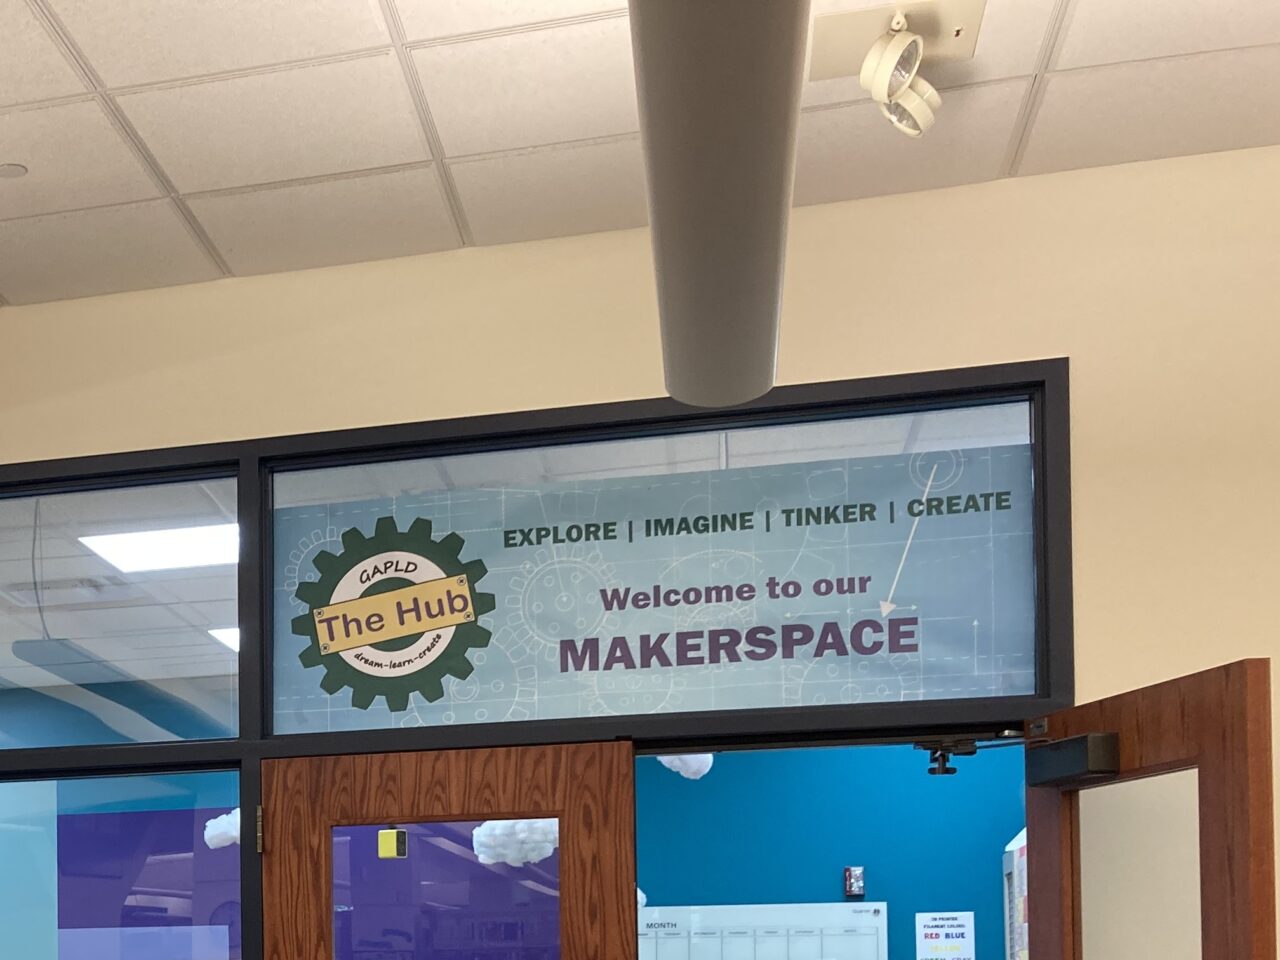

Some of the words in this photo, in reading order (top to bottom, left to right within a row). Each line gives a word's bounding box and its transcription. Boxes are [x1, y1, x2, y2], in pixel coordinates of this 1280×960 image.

[503, 521, 617, 548] EXPLORE
[644, 511, 754, 538] IMAGINE
[781, 502, 877, 528] TINKER
[907, 491, 1012, 518] CREATE
[359, 560, 418, 584] GAPLD
[600, 582, 756, 612] Welcome
[766, 576, 802, 599] to
[812, 575, 872, 596] our
[317, 613, 385, 642] The
[395, 589, 469, 626] Hub
[559, 617, 919, 673] MAKERSPACE
